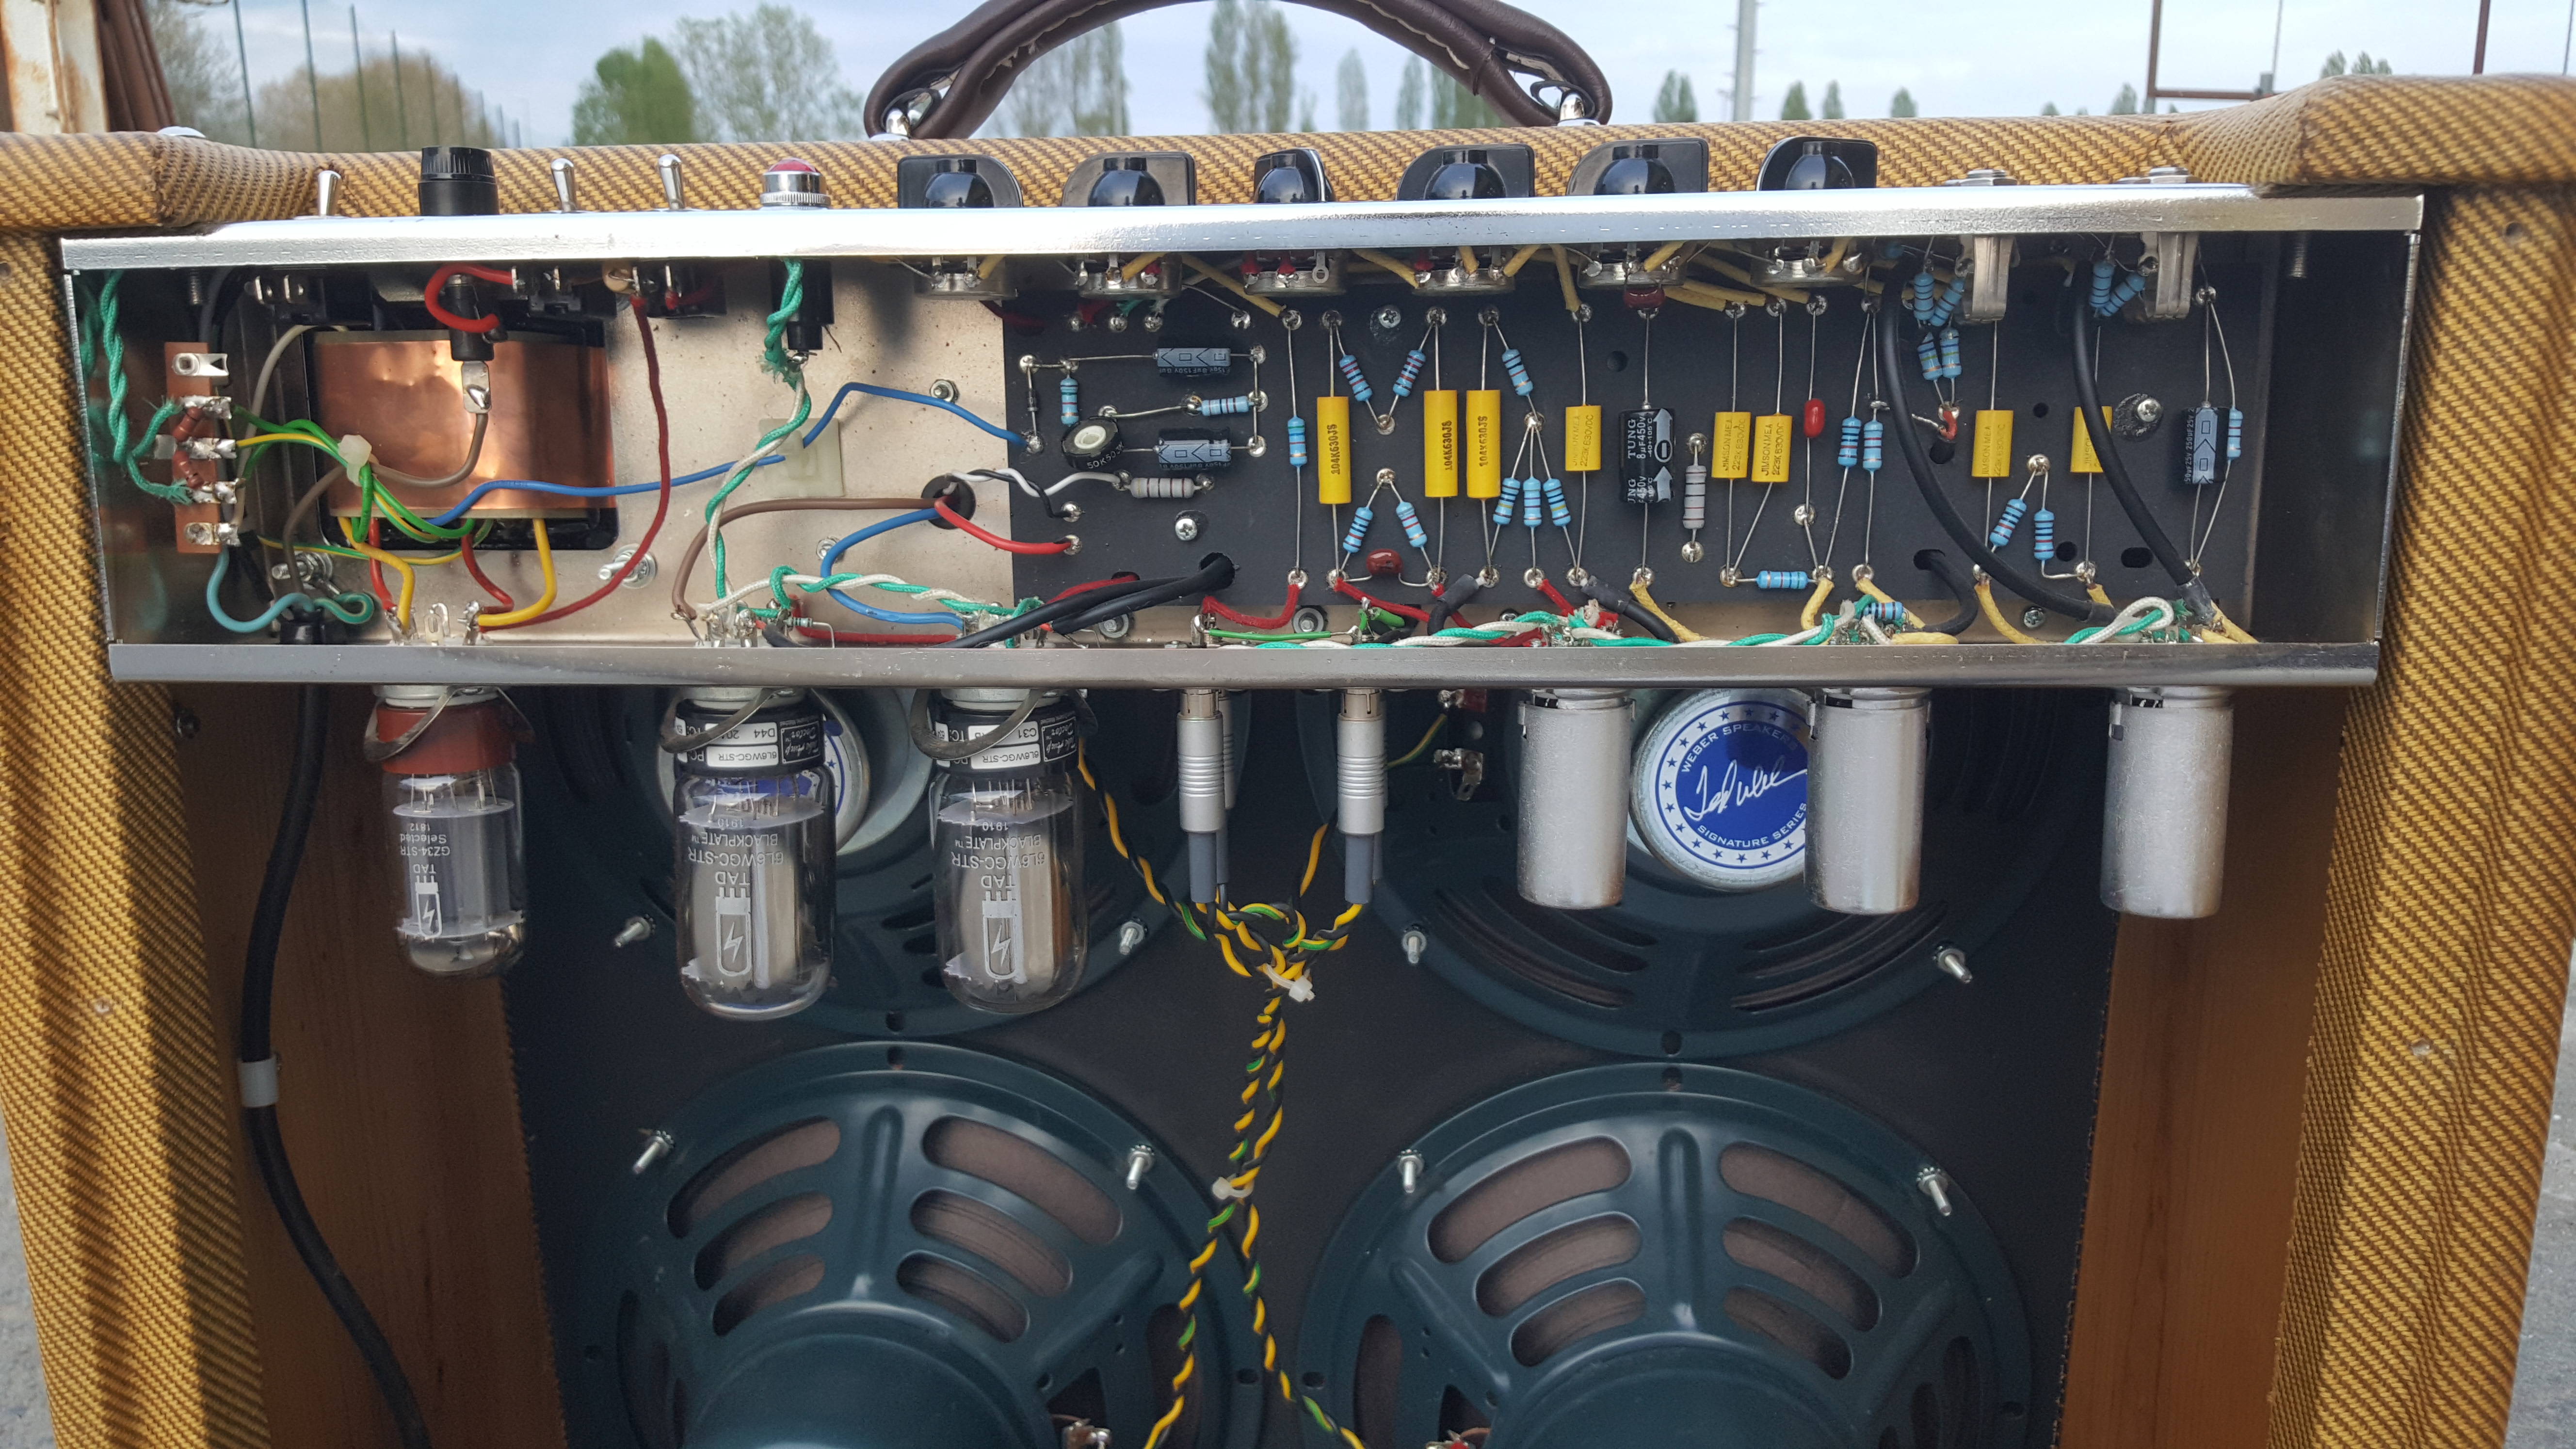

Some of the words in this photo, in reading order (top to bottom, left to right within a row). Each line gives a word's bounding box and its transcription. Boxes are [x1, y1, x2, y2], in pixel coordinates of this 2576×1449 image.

[1583, 414, 1594, 445] 630VDC
[1764, 424, 1772, 441] MEA
[1983, 425, 1991, 443] MEA
[1627, 419, 1636, 459] TUNG
[1580, 447, 1590, 467] 223K
[1722, 438, 1730, 471] JIMSON
[1761, 441, 1770, 476] JIMSON
[1982, 445, 1990, 475] JIMSON
[1771, 455, 1782, 475] 223K
[721, 730, 740, 739] 20
[754, 727, 775, 738] D44
[1017, 728, 1037, 739] C31
[718, 751, 777, 761] 6L6WGC-STR
[1682, 733, 1719, 772] WEBER
[1723, 724, 1797, 750] SPEAKERS
[982, 751, 1039, 764] 6L6WGC-STR
[410, 823, 430, 831] 1812
[717, 818, 744, 828] 1910
[982, 821, 1009, 831] 1910
[1697, 825, 1770, 848] SIGNATURE
[1772, 803, 1807, 840] SERIES
[400, 834, 447, 844] Selected
[401, 846, 450, 856] GZ34-STR
[688, 847, 784, 867] 6L6WGC-STR
[950, 852, 1046, 869] 6L6WGC-STR
[413, 864, 436, 874] TAD
[715, 871, 750, 886] TAD
[981, 875, 1015, 888] TAD
